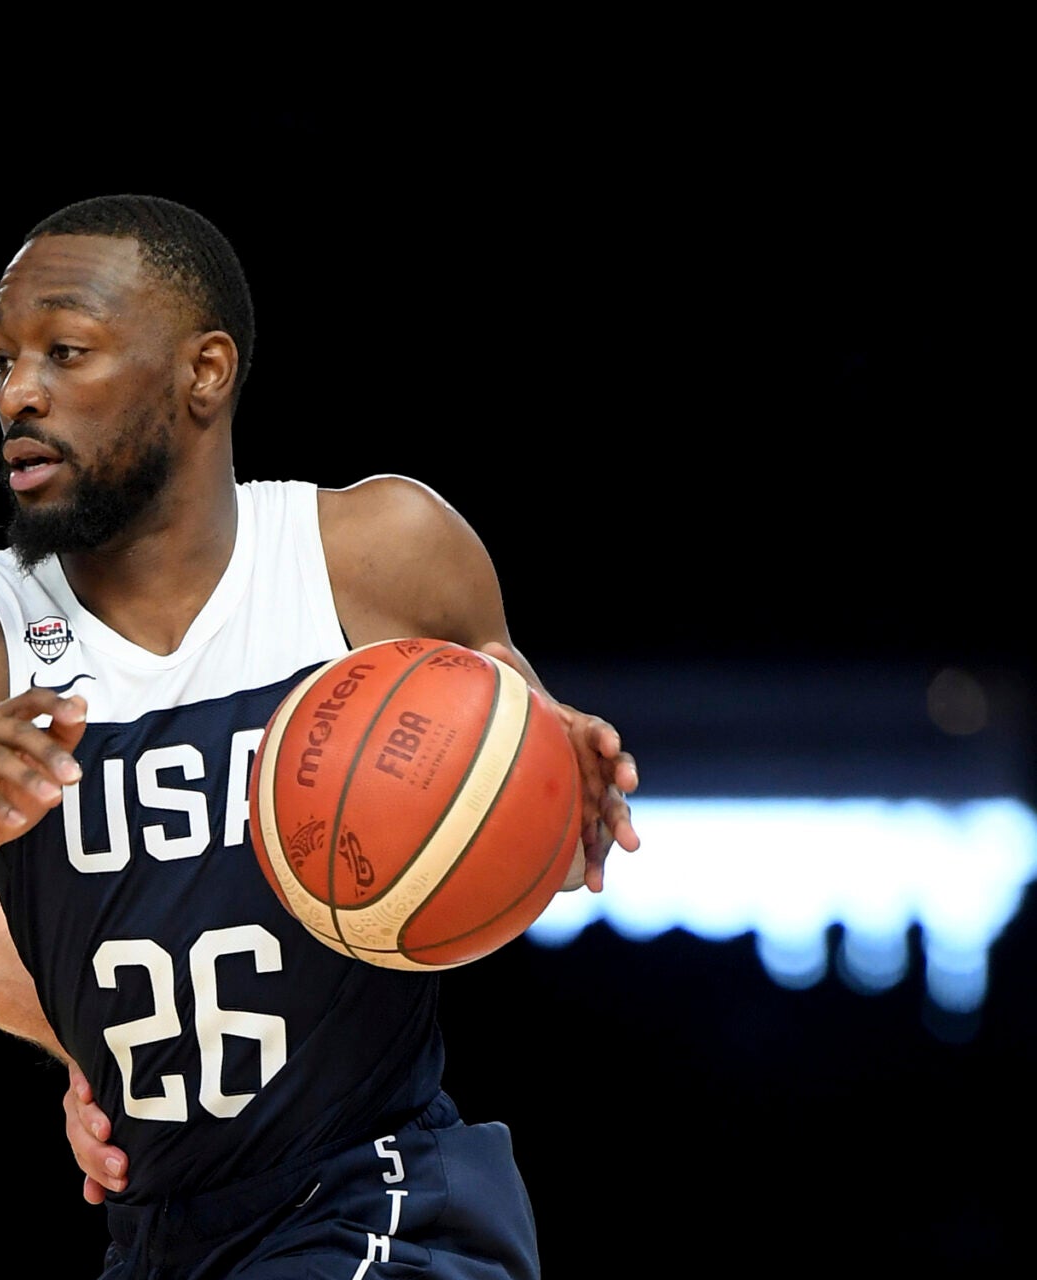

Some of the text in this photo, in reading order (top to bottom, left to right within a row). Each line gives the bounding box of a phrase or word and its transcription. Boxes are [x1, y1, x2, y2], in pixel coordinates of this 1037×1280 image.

[32, 622, 63, 637] USA
[296, 664, 376, 788] molten
[375, 711, 432, 780] FIBA
[92, 924, 287, 1122] 26
